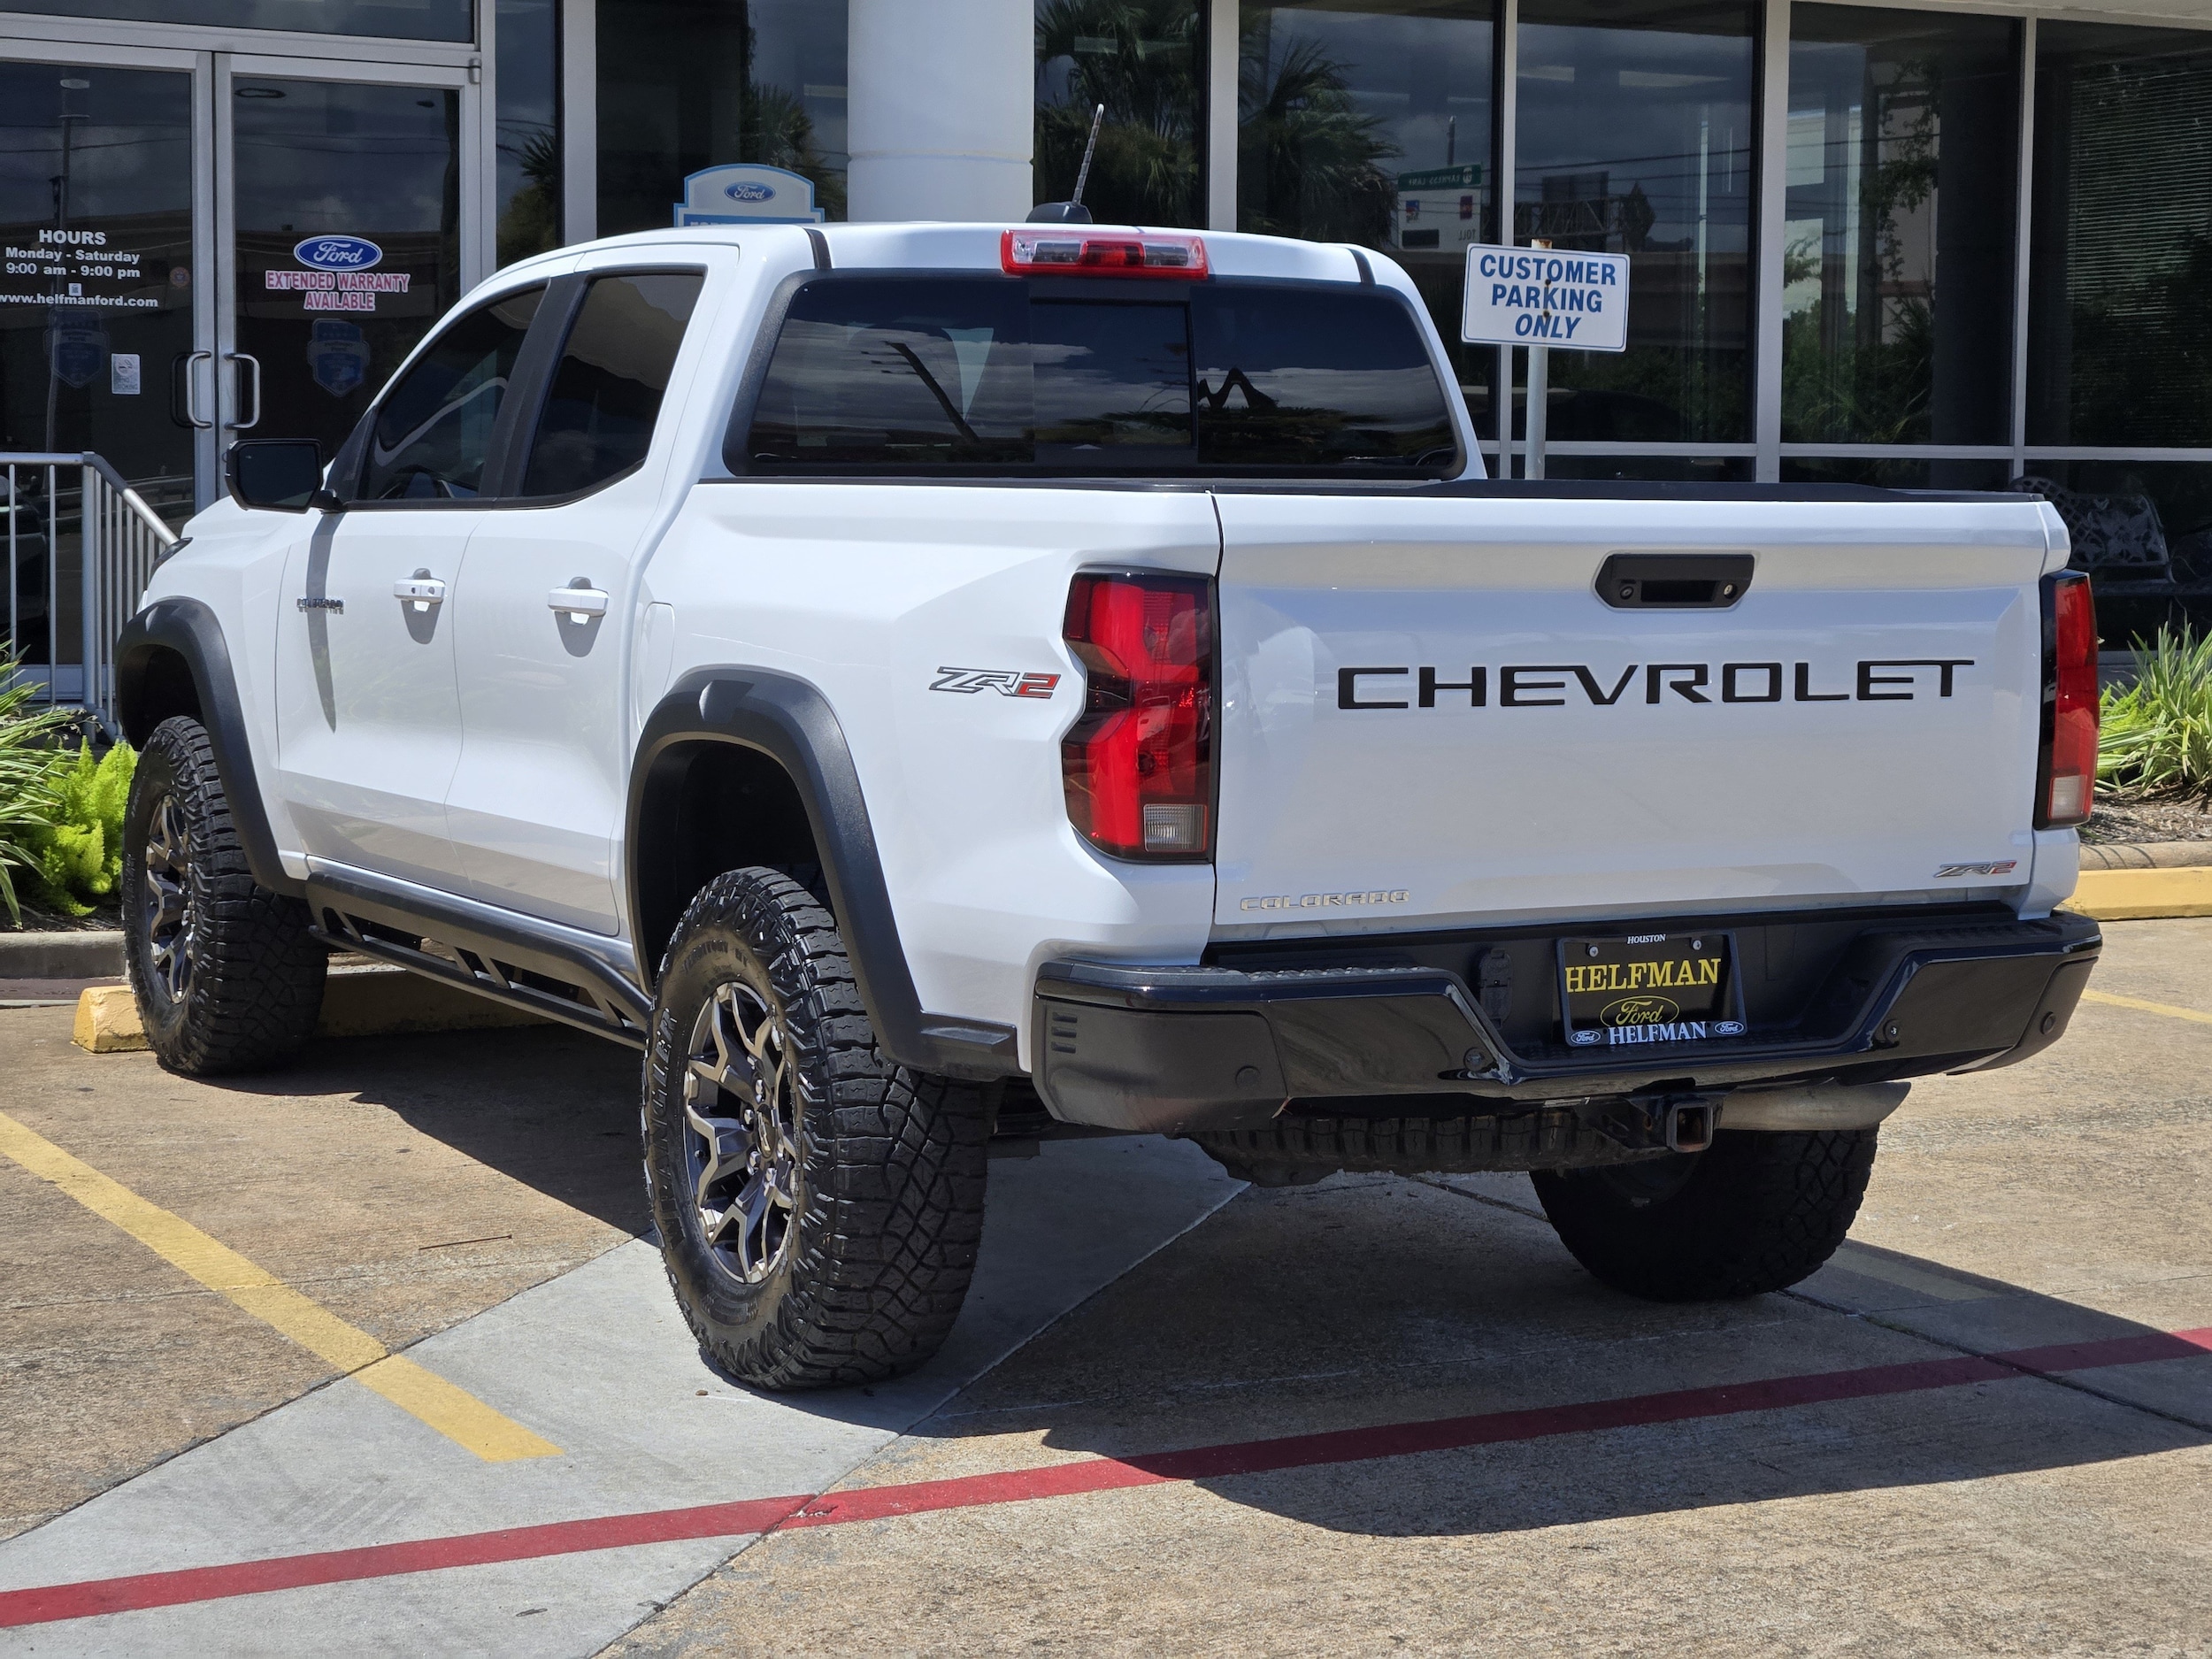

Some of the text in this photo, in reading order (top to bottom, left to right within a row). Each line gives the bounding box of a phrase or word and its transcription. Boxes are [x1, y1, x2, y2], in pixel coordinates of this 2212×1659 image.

[734, 184, 765, 200] Ford
[39, 229, 107, 246] HOURS
[5, 247, 63, 262] Monday
[75, 250, 140, 265] Saturday
[313, 242, 364, 264] Ford
[6, 262, 37, 274] 9:00
[43, 266, 66, 275] am
[81, 265, 113, 276] 9:00
[118, 268, 141, 280] pm
[1480, 254, 1617, 286] CUSTOMER
[266, 271, 411, 293] EXTENDED WARRANTY
[304, 292, 375, 311] AVAILABLE
[1491, 283, 1602, 313] PARKING
[1515, 313, 1582, 339] ONLY
[929, 666, 1061, 699] ZR2
[1338, 659, 1975, 710] CHEVROLET
[1932, 860, 2017, 879] ZR2
[1240, 889, 1410, 911] COLORADO
[1627, 933, 1667, 945] HOUSTON
[1565, 958, 1721, 993] HELFMAN
[1616, 1001, 1664, 1025] Ford
[1608, 1021, 1708, 1045] HELFMAN
